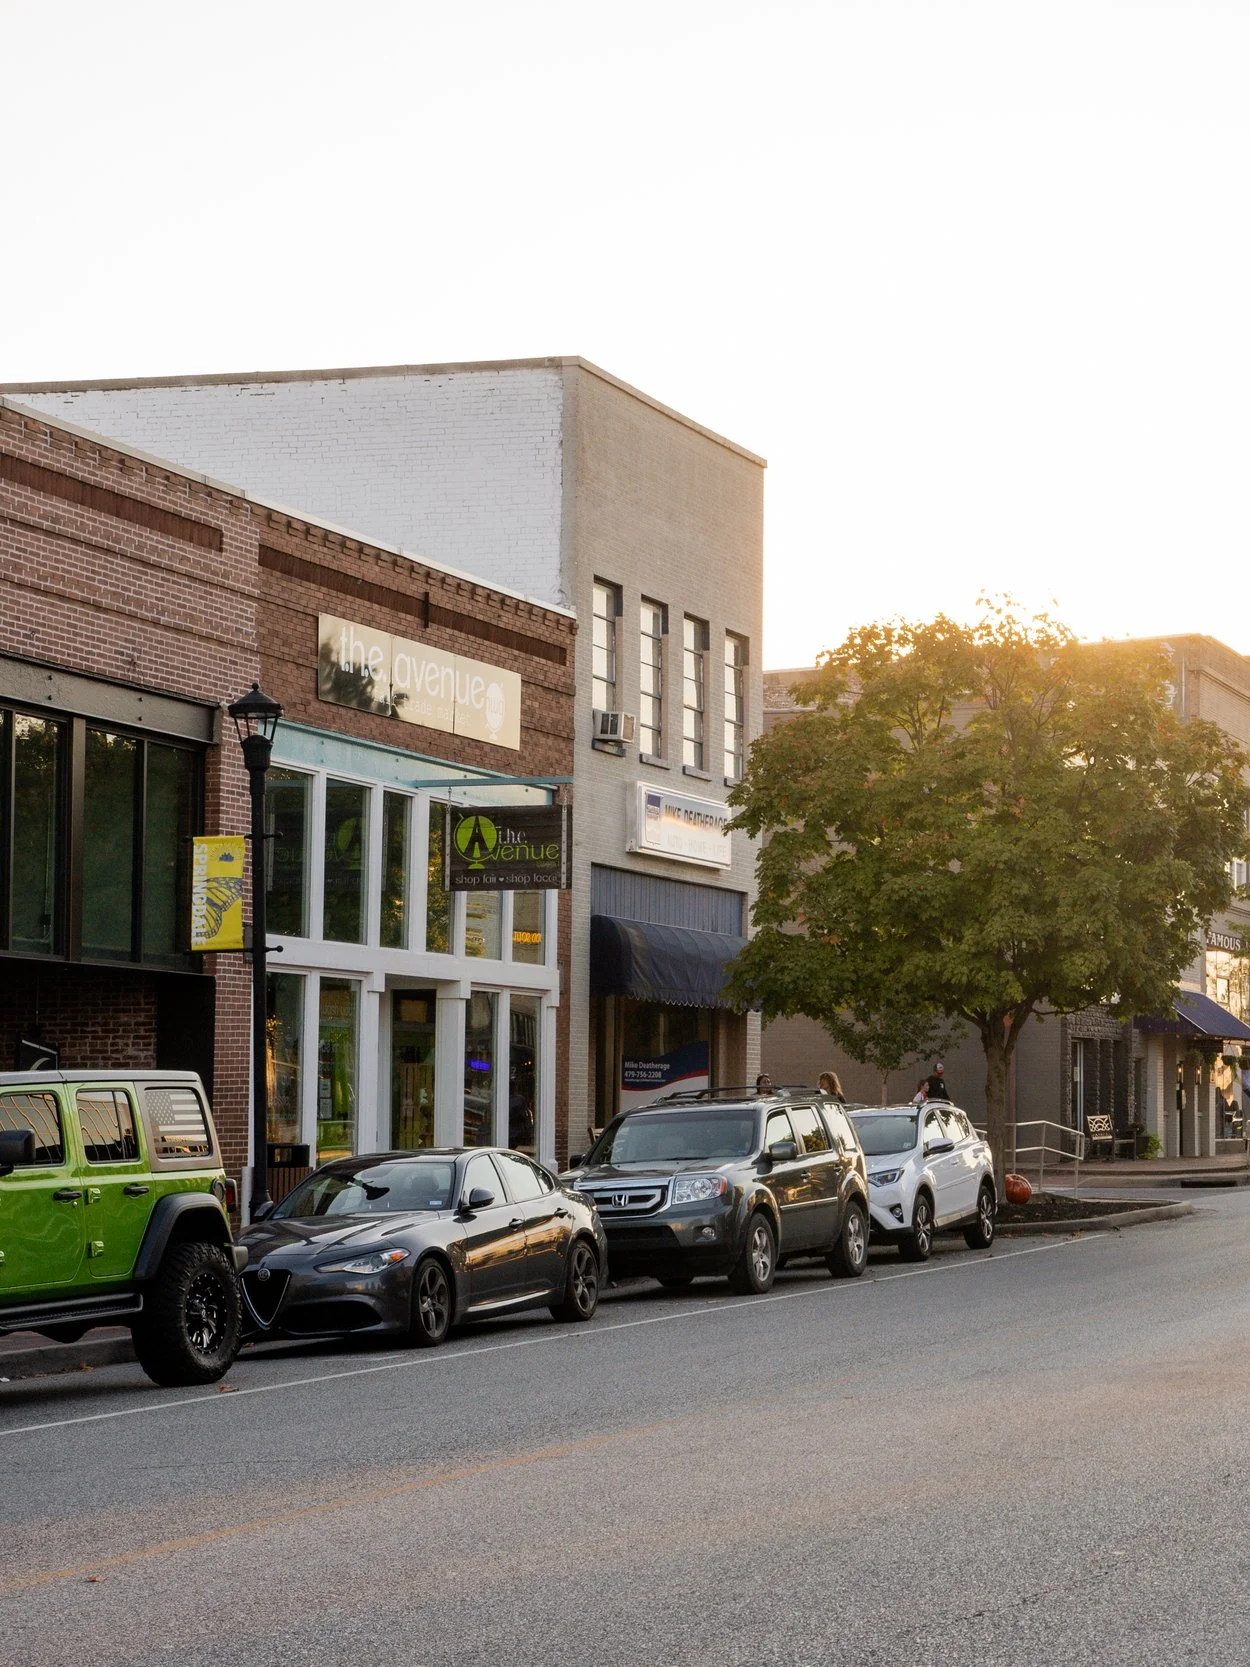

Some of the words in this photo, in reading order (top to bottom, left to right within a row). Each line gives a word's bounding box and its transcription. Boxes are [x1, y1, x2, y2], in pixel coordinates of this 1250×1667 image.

[394, 652, 486, 709] avenue
[665, 804, 682, 819] MIKE
[455, 874, 480, 886] shop
[482, 873, 497, 883] fair
[506, 873, 530, 886] shop
[191, 843, 208, 945] SPRINGDALE
[1206, 931, 1241, 951] FAMOUS
[624, 1061, 638, 1069] Mike
[639, 1061, 670, 1070] Deatherage
